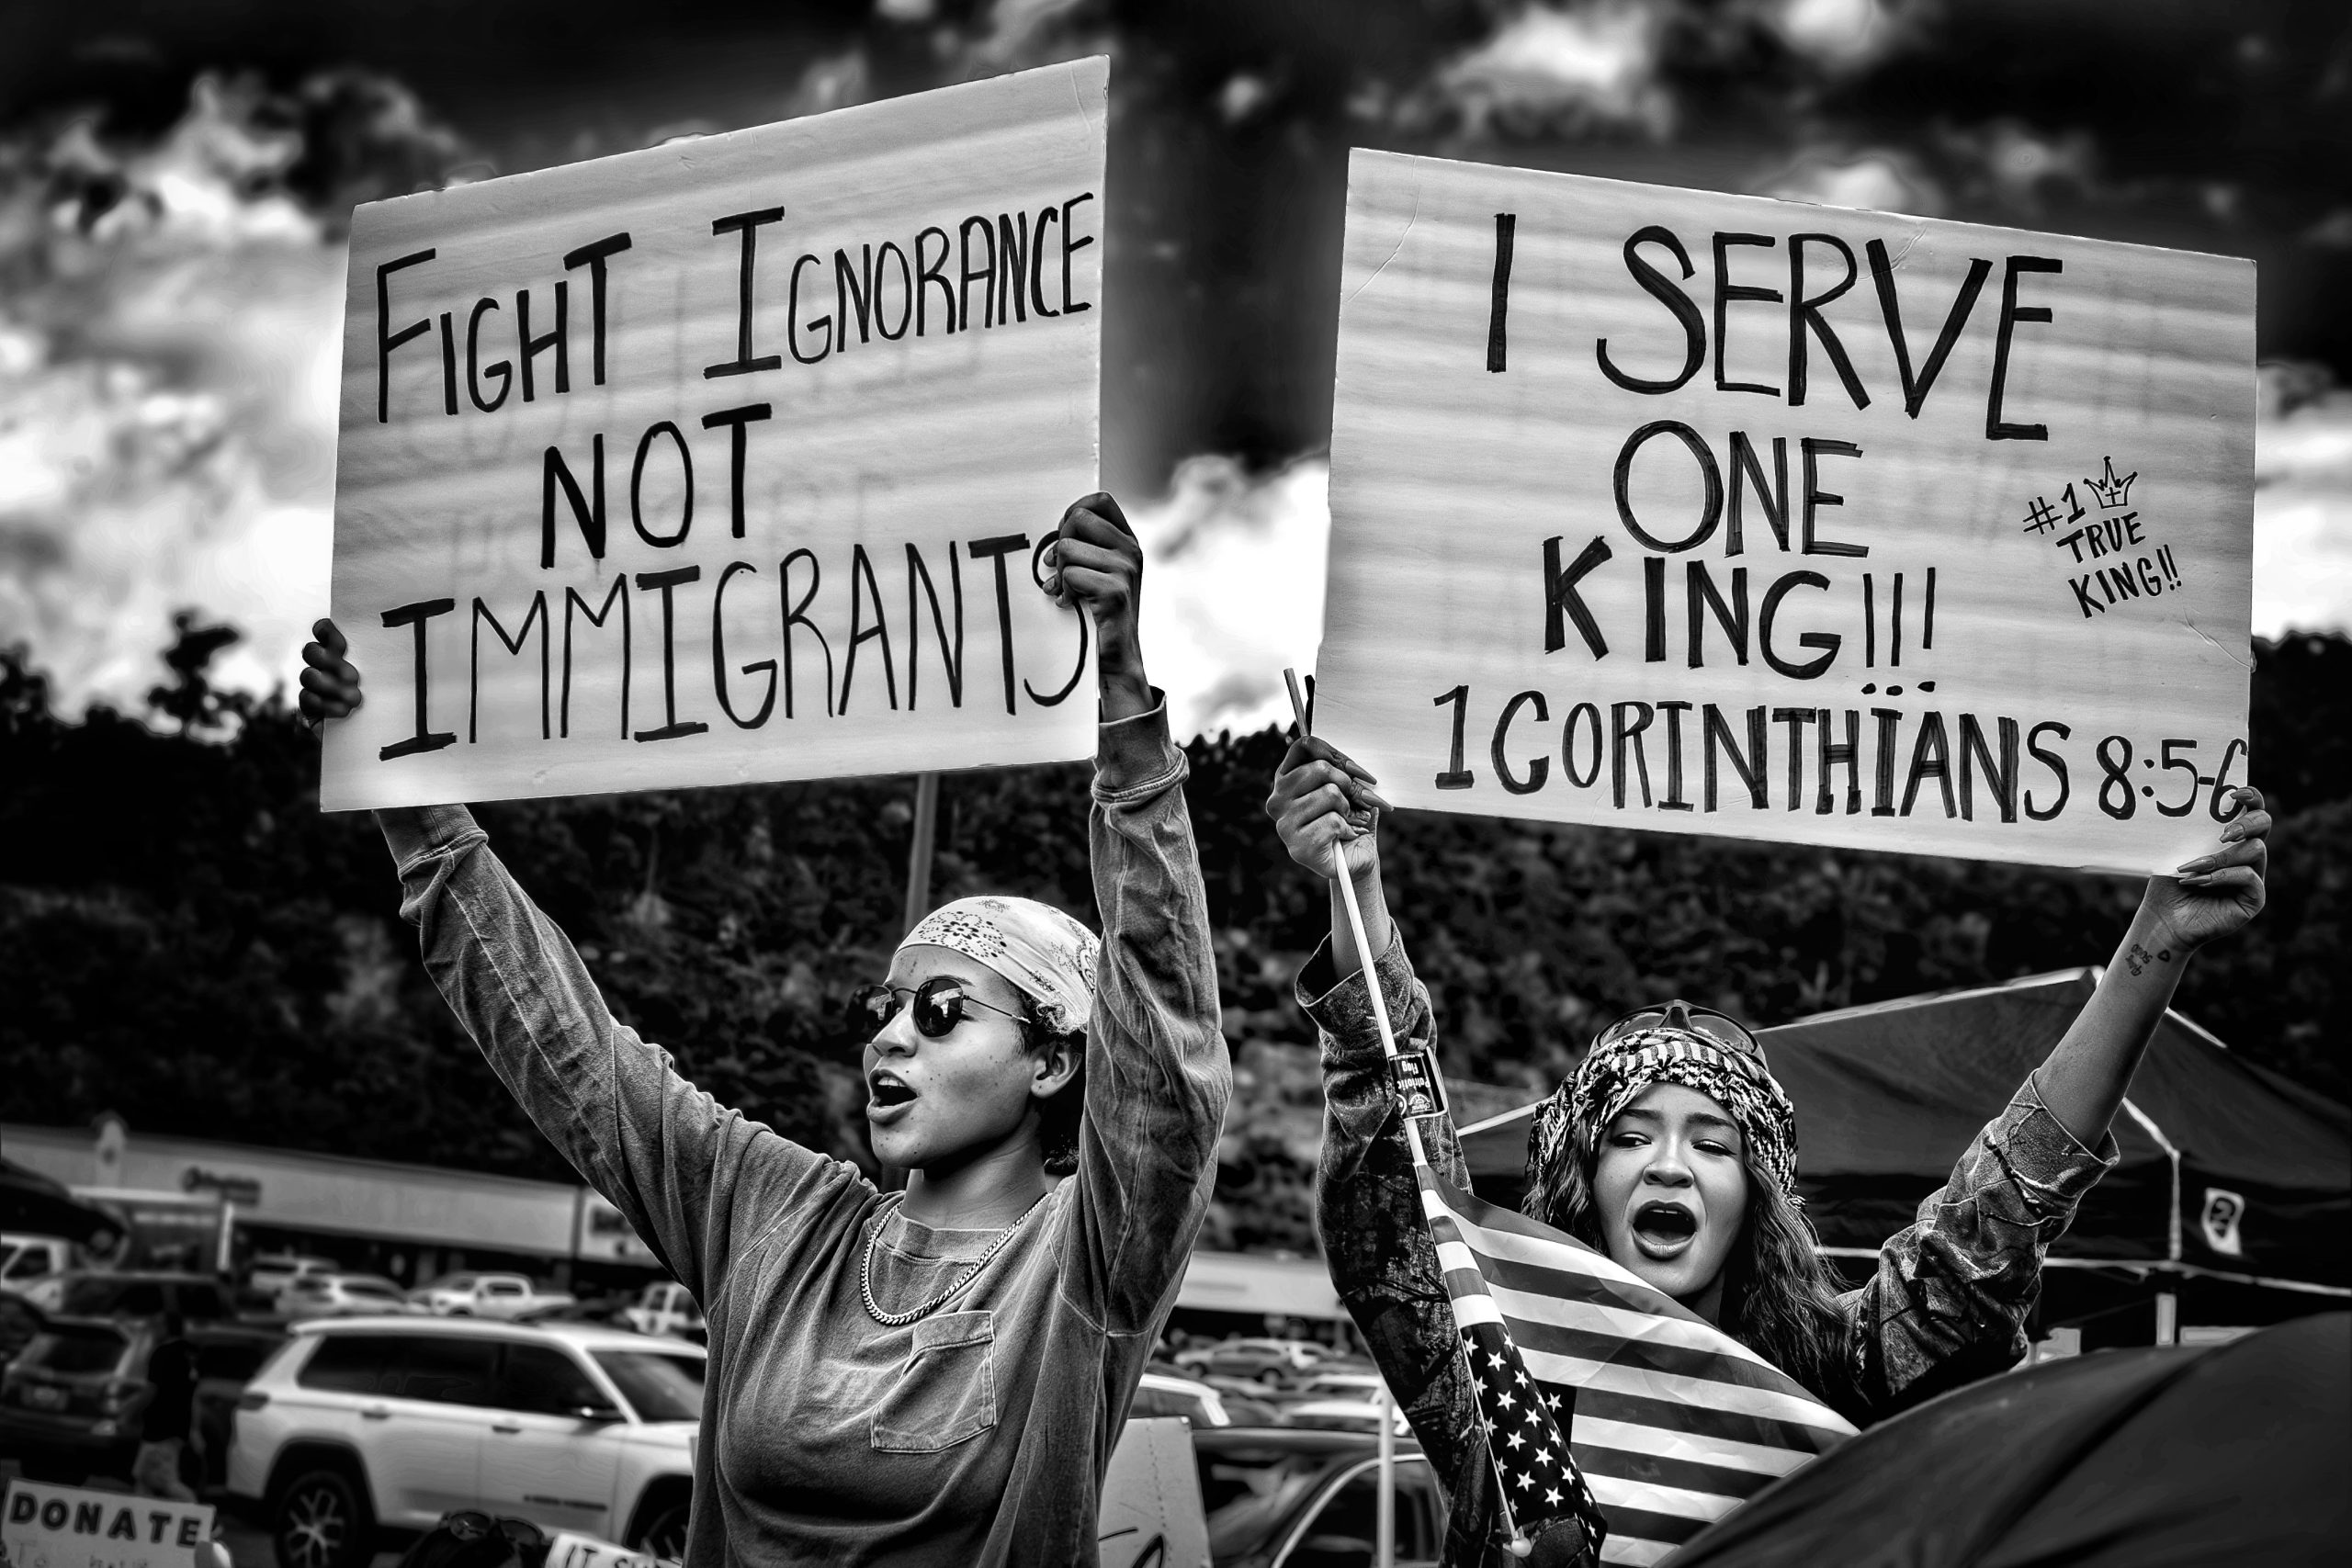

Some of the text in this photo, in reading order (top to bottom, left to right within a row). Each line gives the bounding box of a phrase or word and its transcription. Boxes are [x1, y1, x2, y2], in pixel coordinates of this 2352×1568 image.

[377, 192, 1095, 425] FIGHT IGNORANCE
[1487, 212, 2064, 442] I SERVE
[540, 402, 774, 570] NOT
[1612, 419, 1871, 558] ONE
[2021, 481, 2087, 536] #1
[2054, 511, 2147, 564] TRUE
[379, 521, 1091, 762] IMMIGRANTS
[1542, 535, 1937, 696] KING!!!
[2067, 543, 2183, 619] KING!!
[1433, 683, 2249, 824] 1 CORINTHIANS 8:5-6
[1396, 1077, 1430, 1090] Patriotic
[8, 1491, 203, 1550] DONATE
